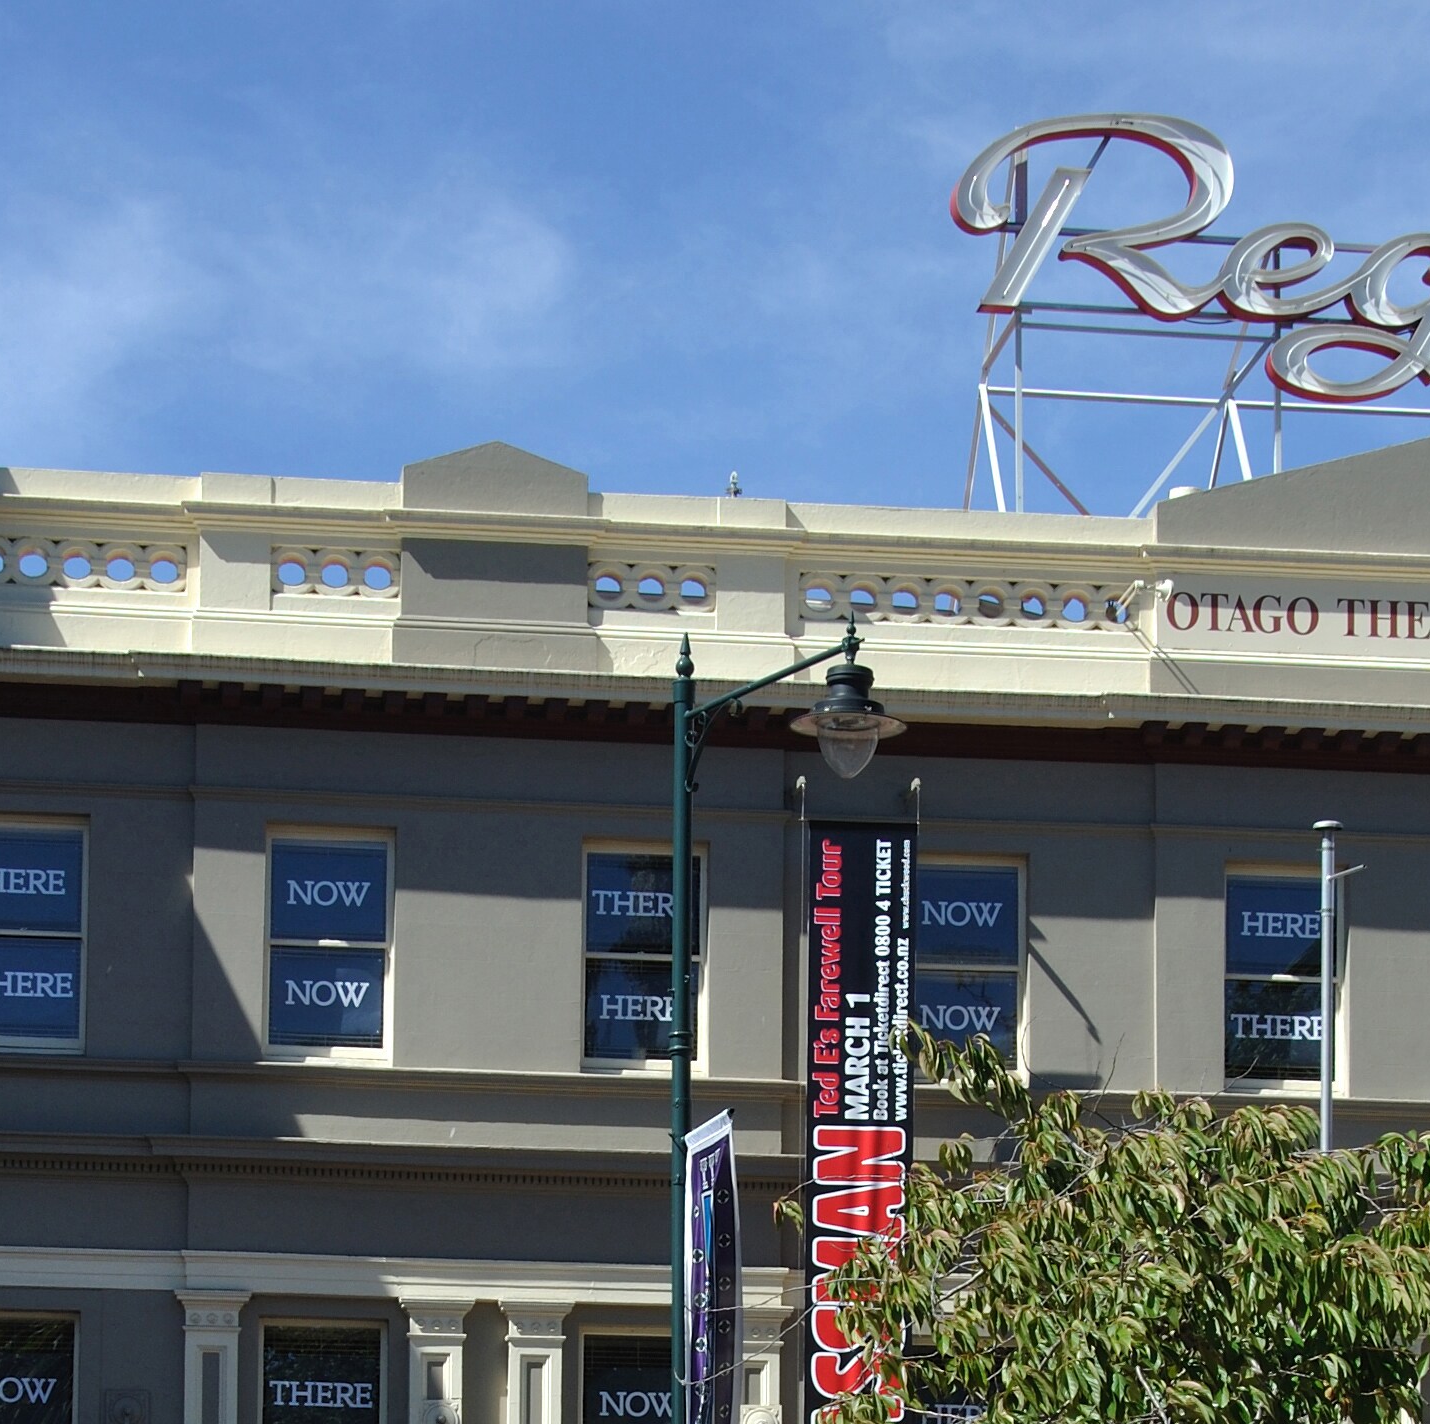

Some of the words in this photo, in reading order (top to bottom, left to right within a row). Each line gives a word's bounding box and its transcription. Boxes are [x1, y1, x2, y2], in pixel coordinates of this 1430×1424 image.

[1166, 590, 1319, 636] OTAGO
[815, 838, 843, 900] Tour
[876, 838, 892, 897] TICKET
[286, 878, 372, 909] NOW
[591, 889, 674, 918] THER
[875, 899, 892, 912] 4
[921, 900, 1003, 928] NOW
[1240, 911, 1321, 939] HERE
[875, 914, 892, 957] 0800
[813, 906, 842, 1021] Farewell
[284, 979, 370, 1009] NOW
[845, 992, 871, 1009] 1
[873, 959, 891, 1055] Ticketdirect
[920, 1004, 1000, 1032] NOW
[813, 1027, 841, 1065] E's
[844, 1017, 871, 1121] MARCH
[875, 1058, 889, 1076] at
[813, 1071, 841, 1118] Ted
[872, 1079, 889, 1121] Book
[269, 1379, 373, 1409] THERE
